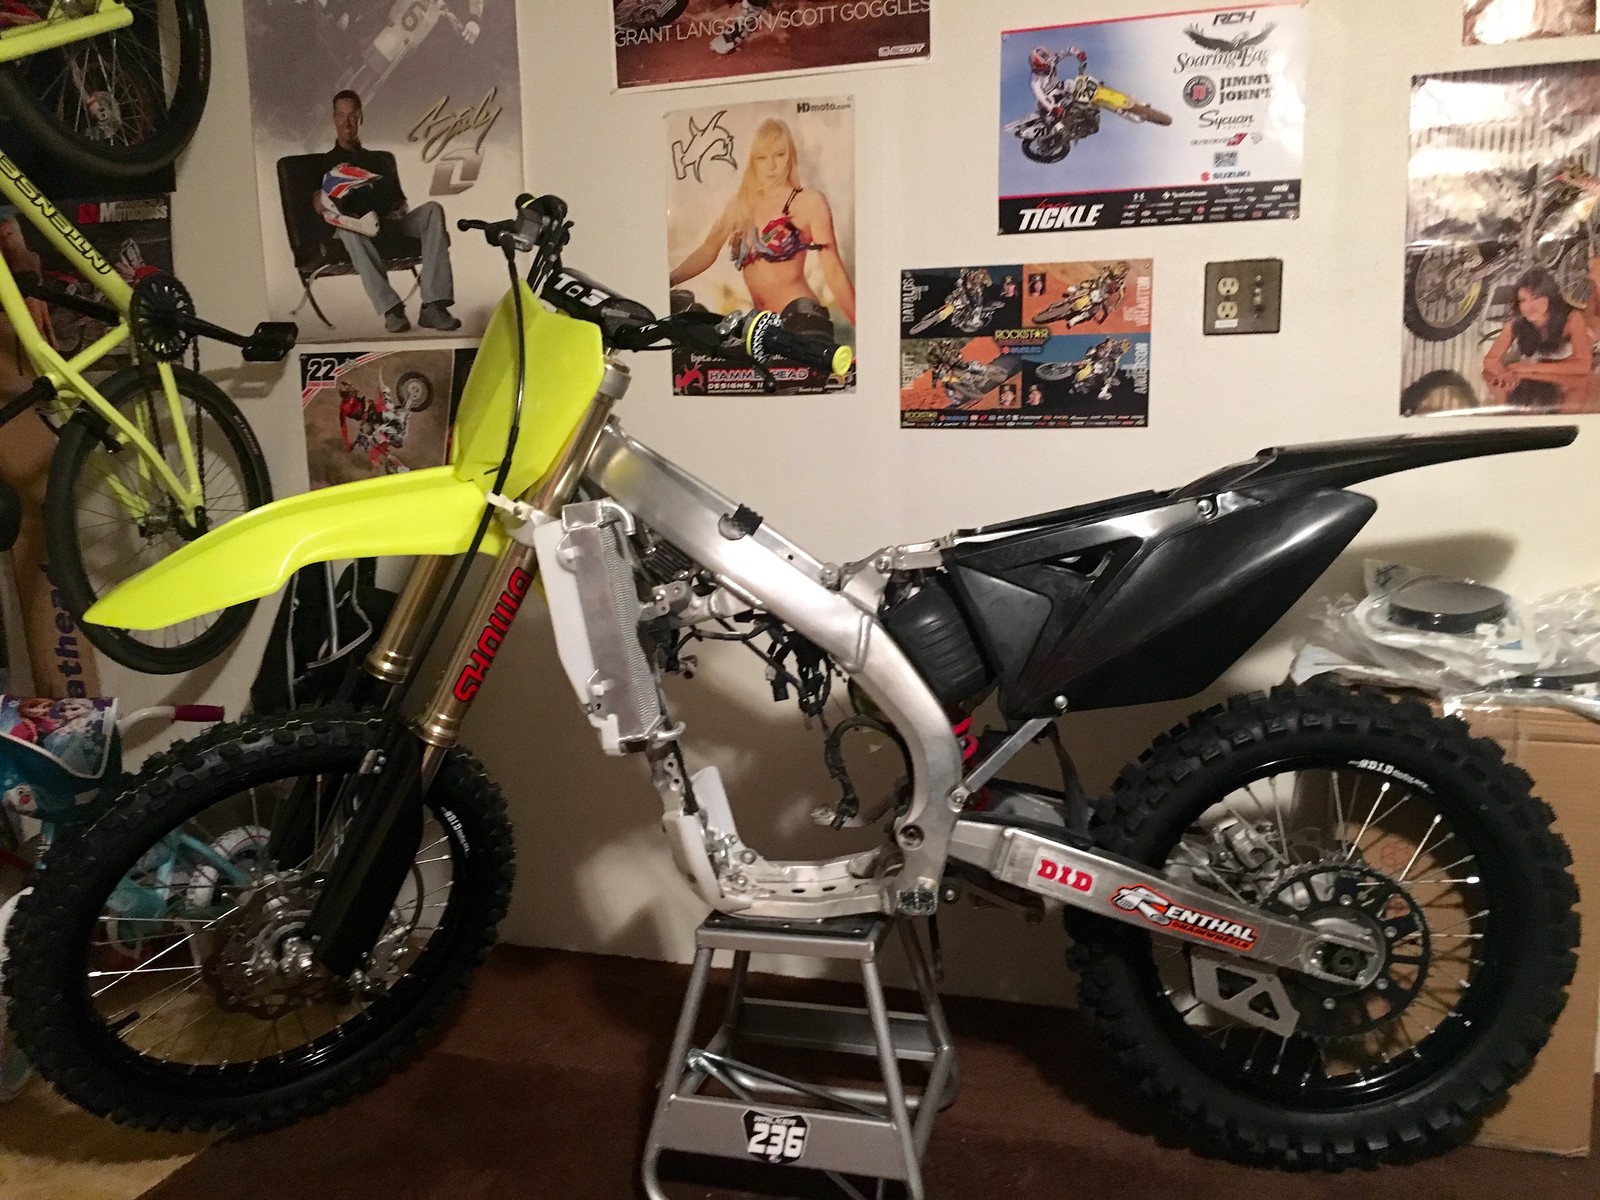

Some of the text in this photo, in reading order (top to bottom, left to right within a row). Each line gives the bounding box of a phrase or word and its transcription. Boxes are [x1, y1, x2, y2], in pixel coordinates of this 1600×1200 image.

[615, 25, 672, 46] GRANT
[840, 0, 931, 22] GOGGLES
[1018, 203, 1105, 231] TICKLE
[307, 357, 338, 382] 22
[1037, 858, 1094, 893] DID
[747, 1121, 806, 1158] 236
